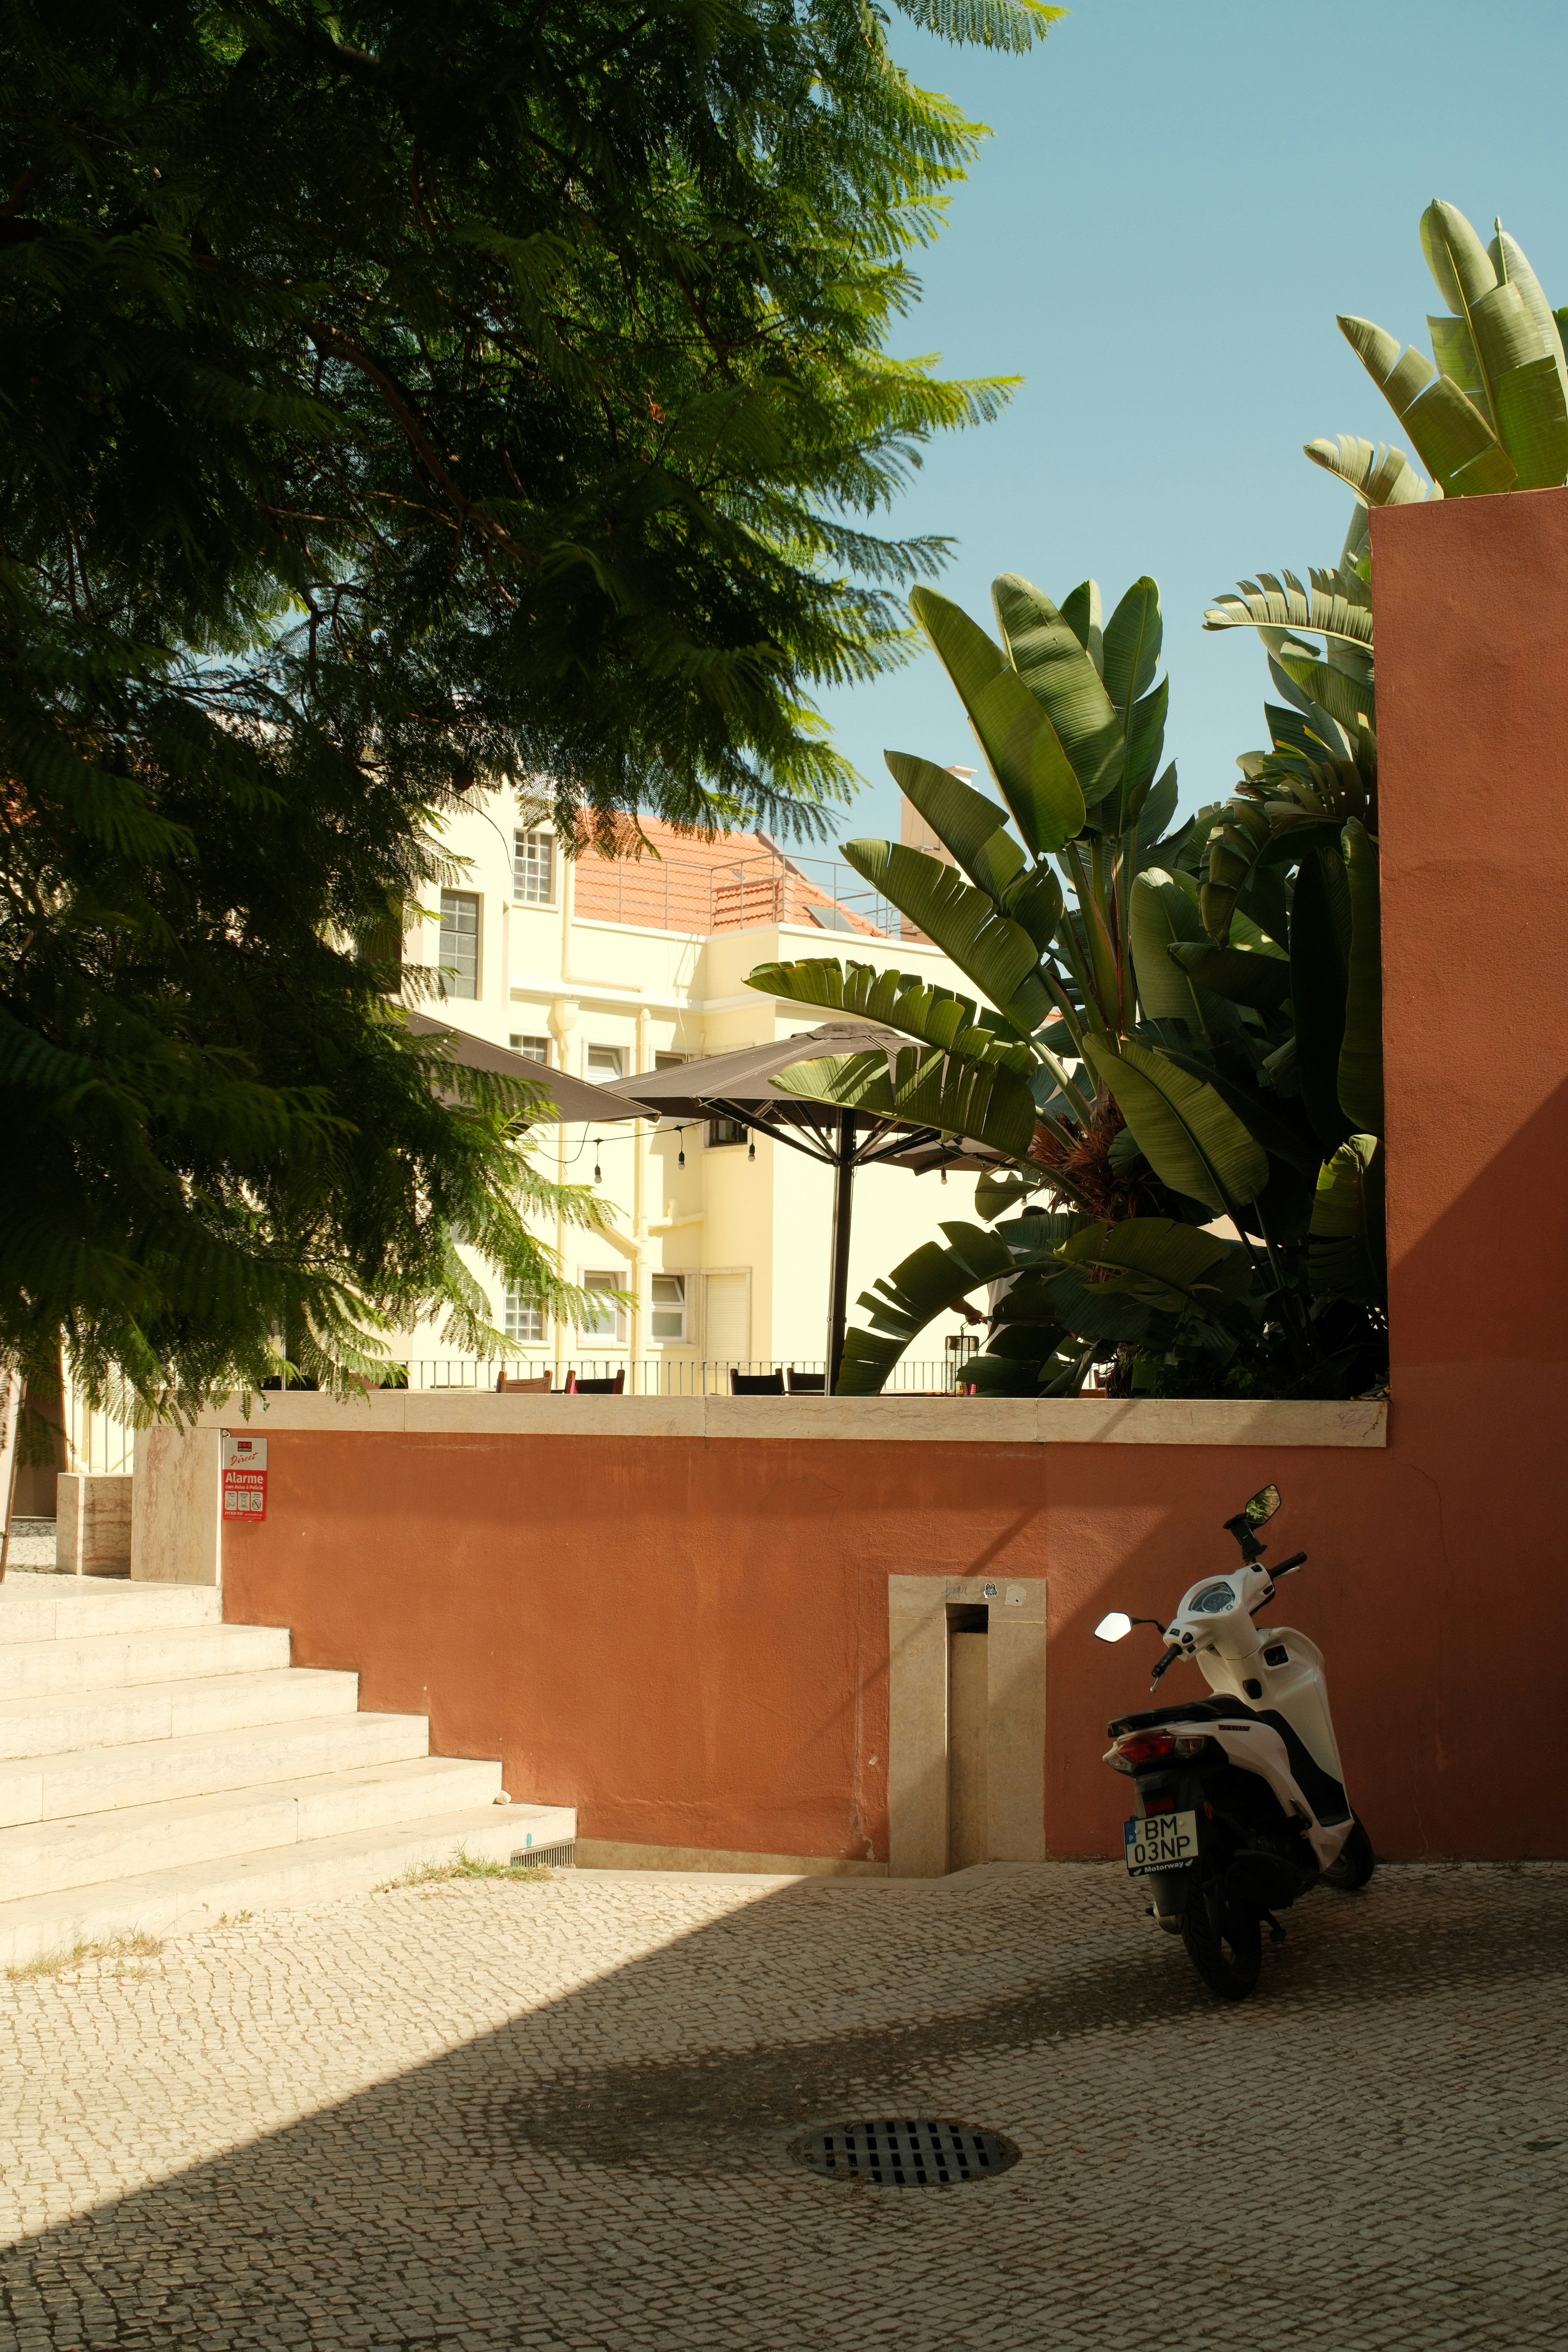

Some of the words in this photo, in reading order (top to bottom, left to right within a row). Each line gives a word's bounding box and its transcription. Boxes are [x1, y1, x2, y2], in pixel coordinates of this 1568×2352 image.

[230, 1452, 260, 1465] Direct
[225, 1472, 263, 1484] Alarme
[1145, 1816, 1177, 1840] BM
[1135, 1836, 1190, 1863] 03NP
[1144, 1861, 1184, 1873] Motorway
